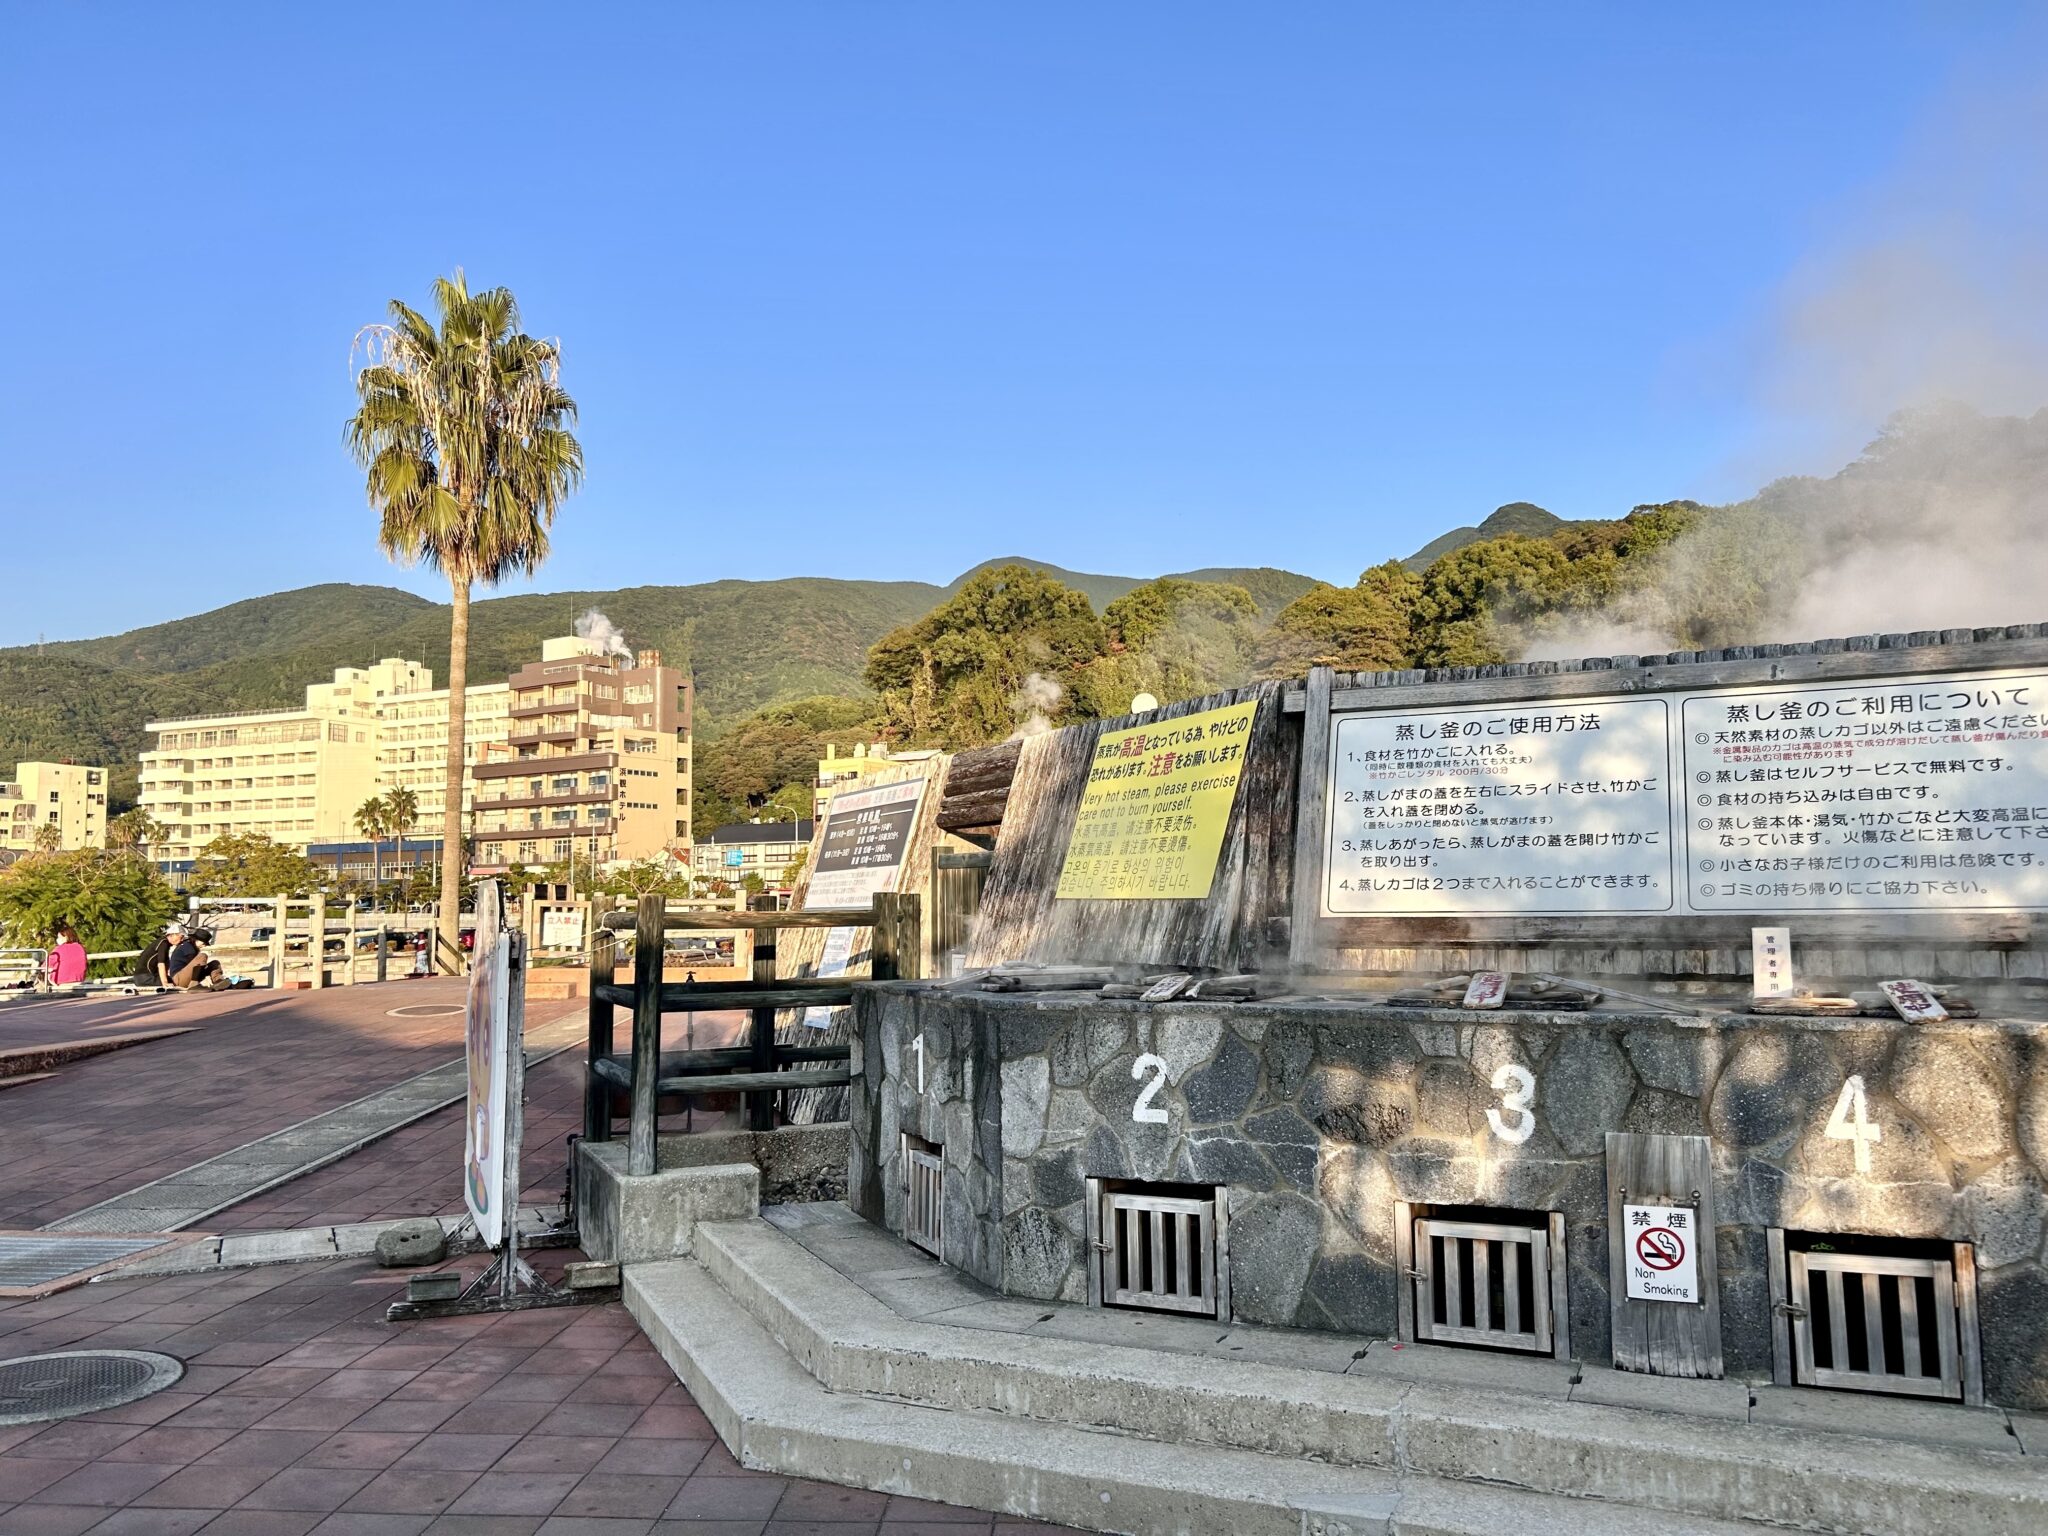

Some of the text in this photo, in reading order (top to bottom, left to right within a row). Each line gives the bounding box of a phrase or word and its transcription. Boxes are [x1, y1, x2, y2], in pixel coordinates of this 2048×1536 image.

[1727, 687, 2030, 723] 蒸し釜のご利用について
[1096, 716, 1249, 760] 蒸気が高温となっている為、やけどの
[1395, 713, 1601, 741] 蒸し釜のご使用方法
[1090, 744, 1243, 783] 恐れがあります。注意をお願いします。
[1723, 750, 1854, 763] に染み込む可能性があります
[1449, 766, 1508, 777] 200円/30分
[1084, 773, 1236, 806] Very hot steam, please exercise
[1079, 796, 1193, 820] care not to burn yourself.
[1363, 804, 1485, 819] を入れ蓋を閉める。
[1064, 861, 1090, 876] 고온의
[1092, 859, 1119, 876] 증기로
[1122, 857, 1151, 875] 화상의
[1361, 855, 1439, 868] を取り出す。
[1099, 875, 1145, 893] 주의하시기
[1148, 873, 1191, 892] 바랍니다.
[1766, 936, 1779, 991] 管理者専用
[912, 1033, 925, 1094] 1
[1131, 1052, 1168, 1124] 2
[1485, 1064, 1536, 1145] 3
[1824, 1075, 1881, 1173] 4
[1631, 1211, 1687, 1229] 禁煙
[1635, 1267, 1655, 1279] Non
[1643, 1283, 1689, 1298] Smoking
